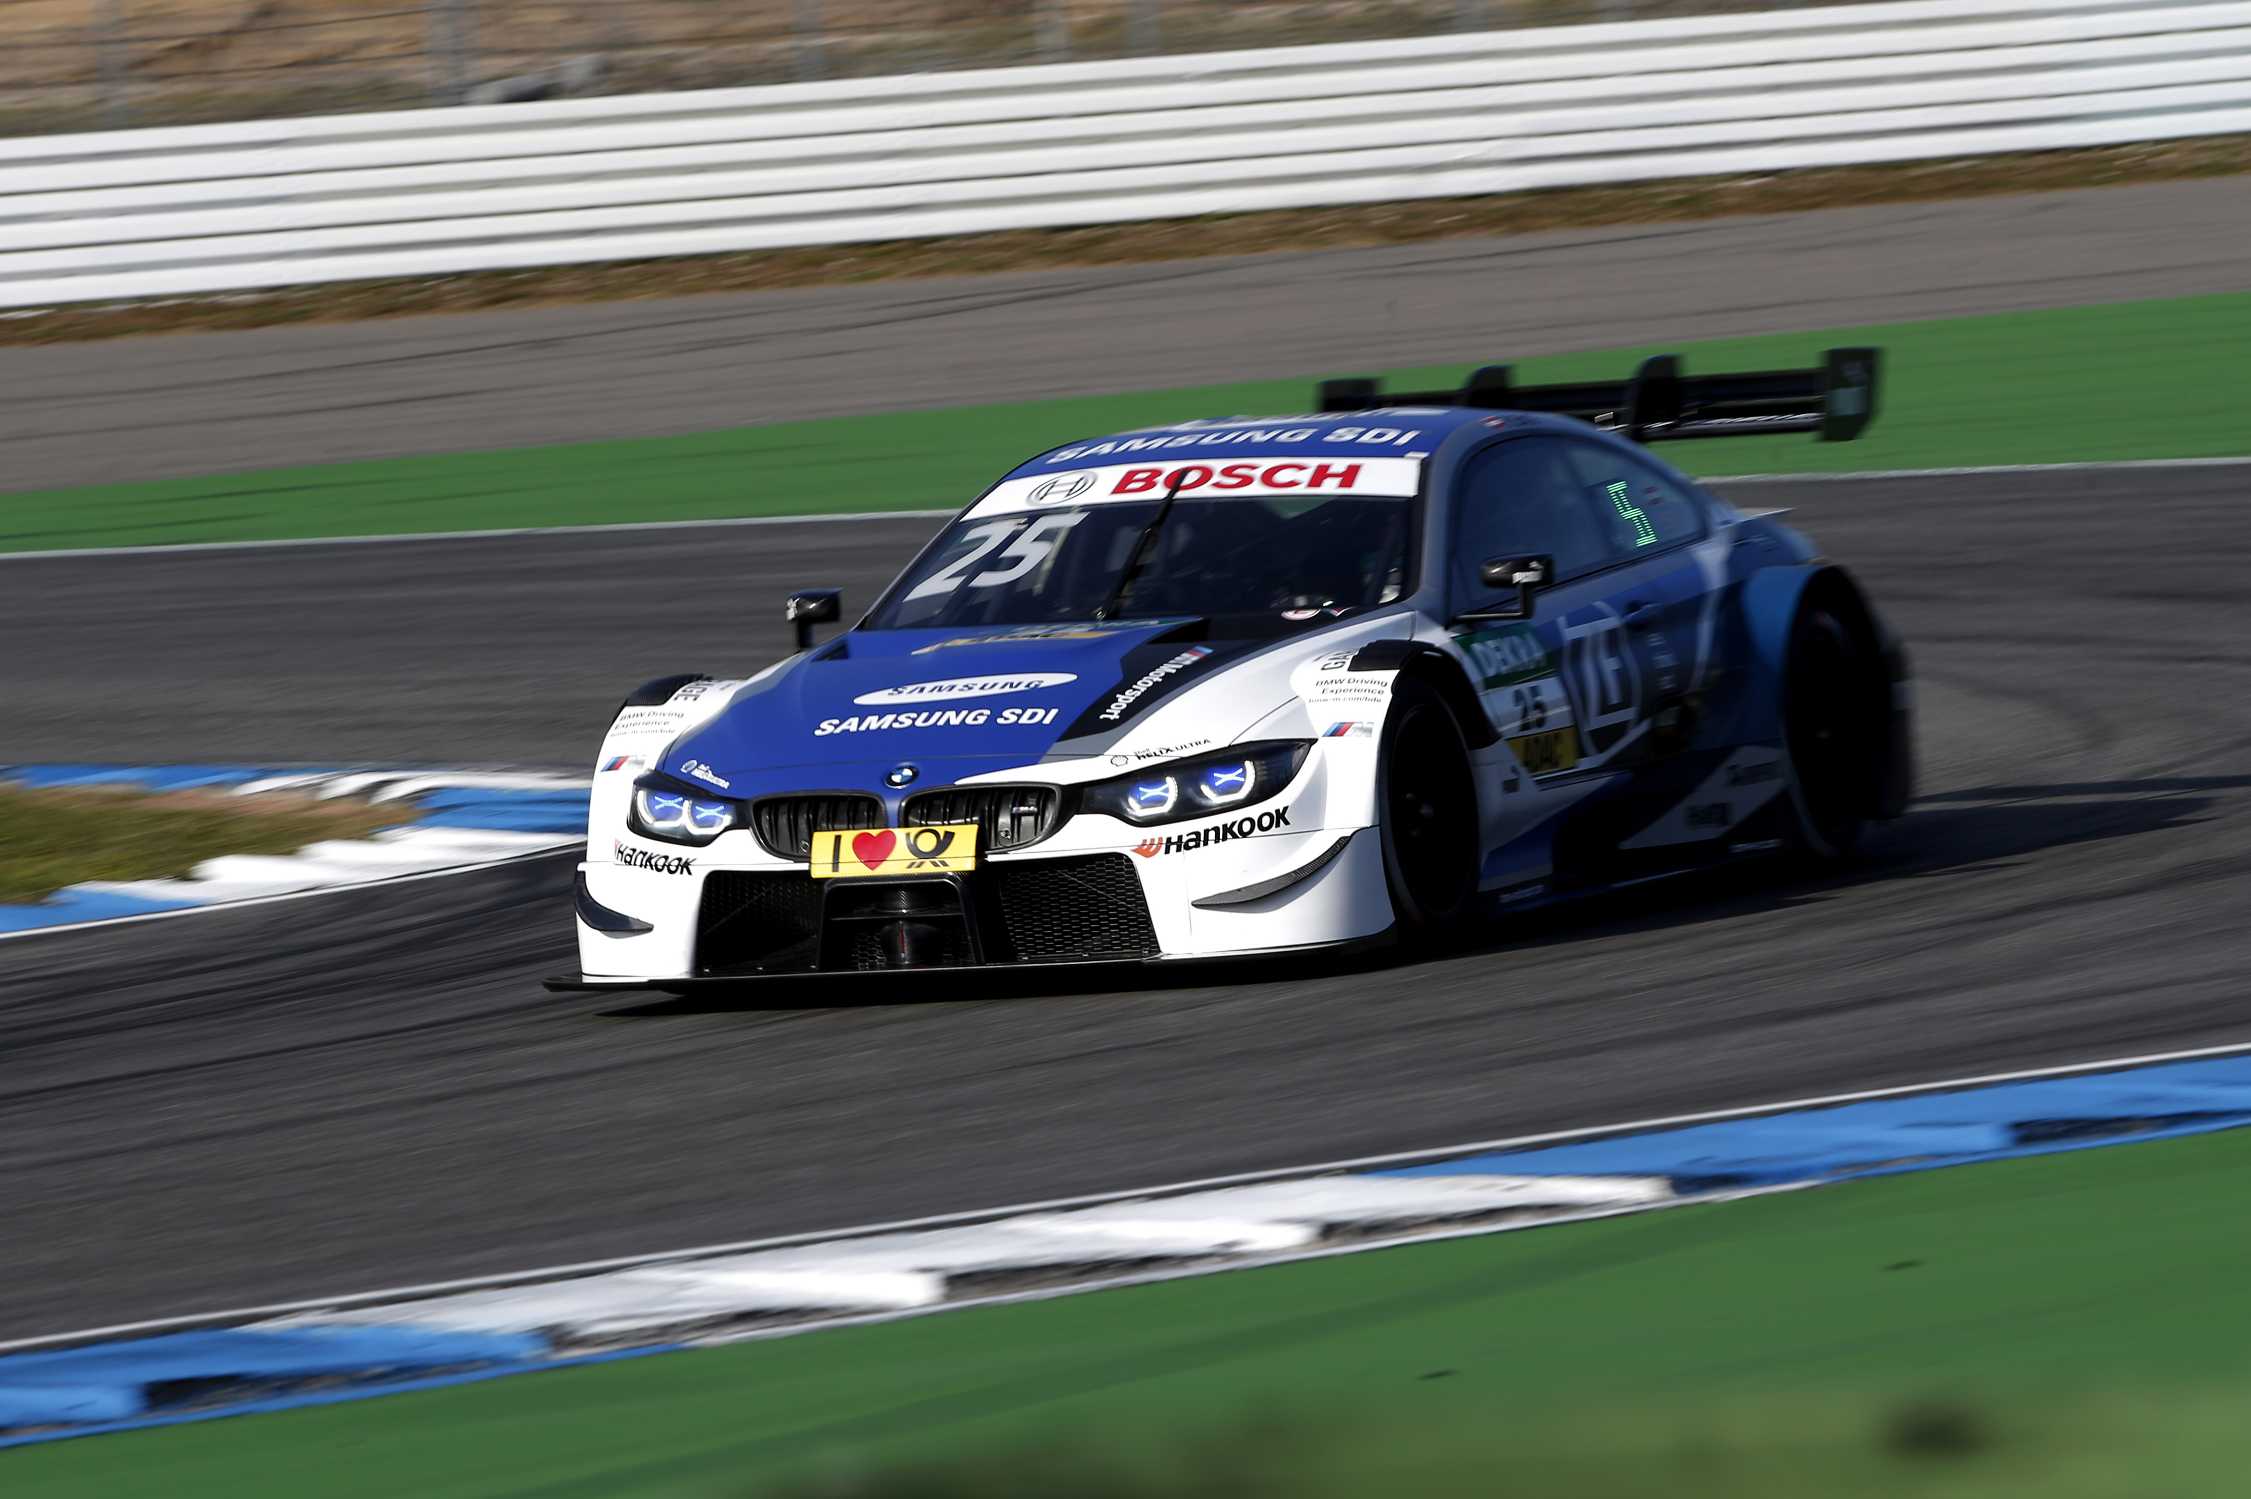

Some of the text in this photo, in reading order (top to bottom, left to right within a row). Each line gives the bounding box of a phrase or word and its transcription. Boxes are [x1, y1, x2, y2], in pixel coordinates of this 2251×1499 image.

[1045, 426, 1423, 464] SAMSUNG SDI
[1108, 463, 1363, 495] BOSCH
[902, 511, 1091, 603] 25
[1470, 633, 1546, 678] DEKRA
[887, 679, 1045, 697] SAMSUNG
[1315, 677, 1389, 688] BMW Driving
[1321, 687, 1385, 696] Experience
[813, 707, 1060, 737] SAMSUNG SDI
[832, 834, 842, 873] I
